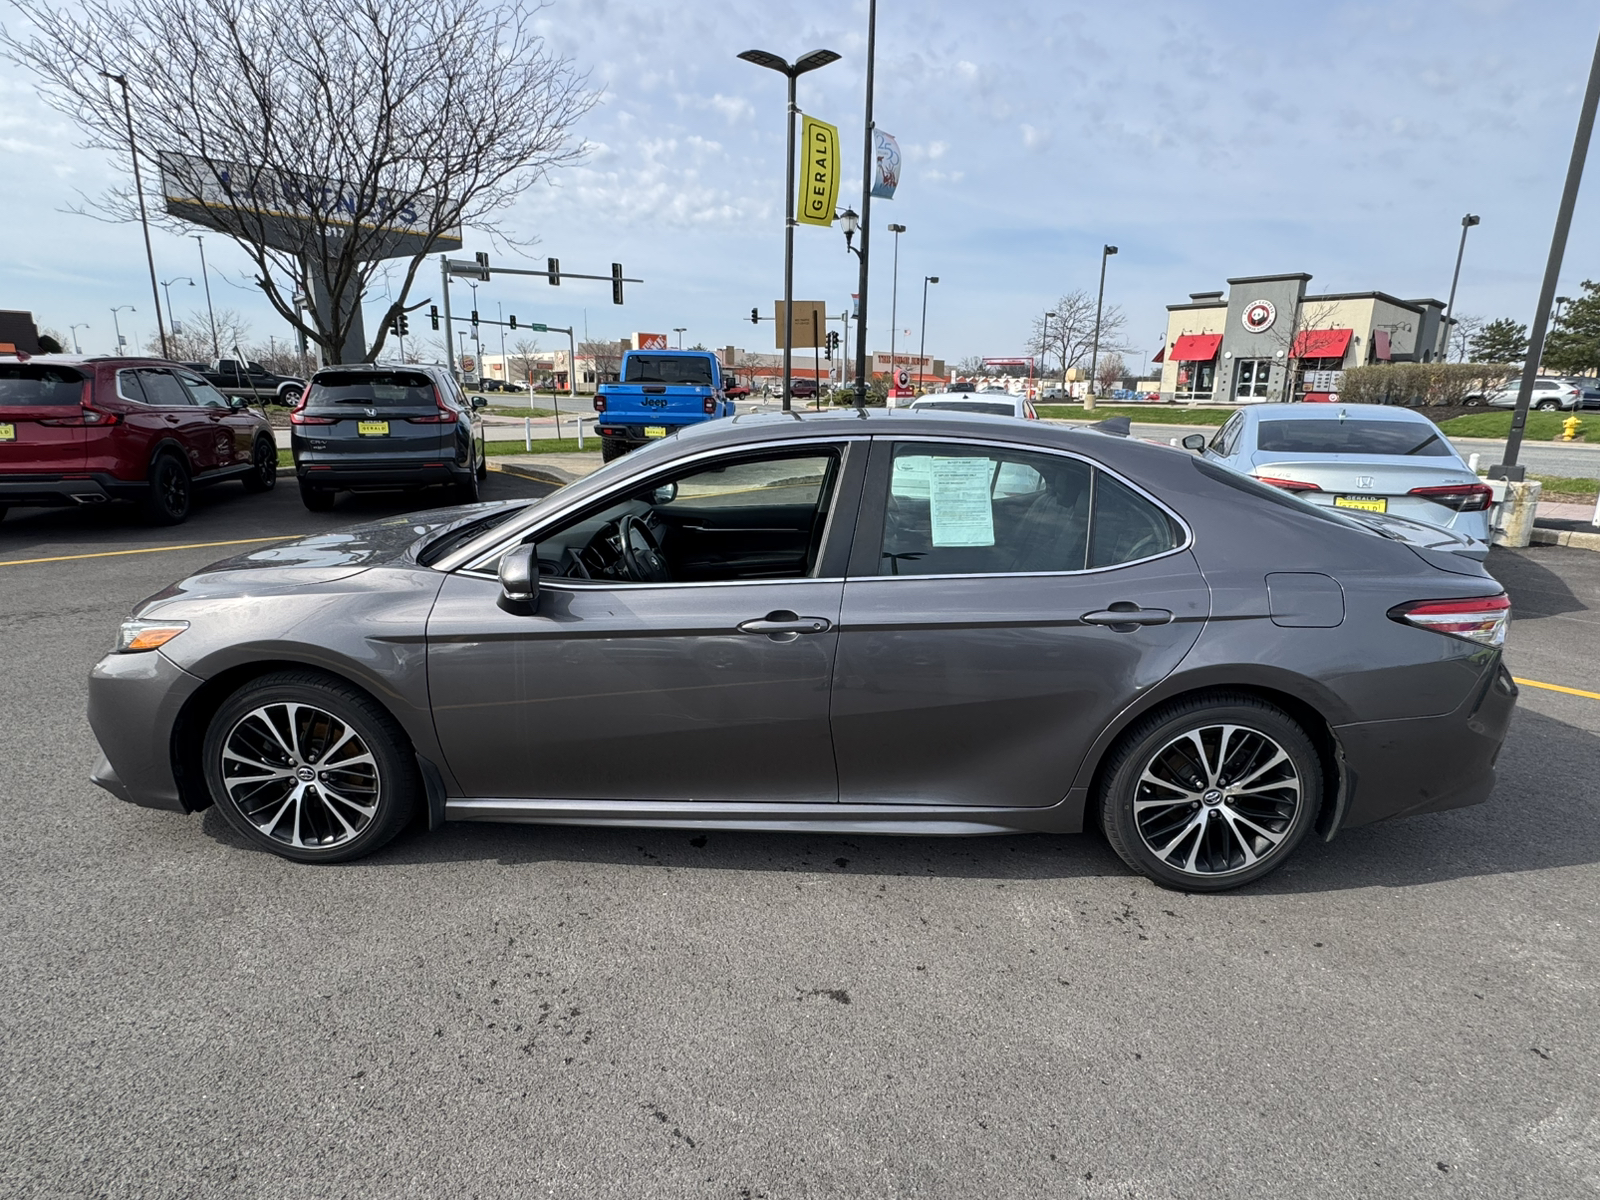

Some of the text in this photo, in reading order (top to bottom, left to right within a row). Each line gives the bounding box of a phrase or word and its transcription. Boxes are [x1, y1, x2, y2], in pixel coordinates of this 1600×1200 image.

[876, 134, 900, 166] 250
[812, 132, 827, 212] GERALD
[641, 397, 668, 408] Jeep
